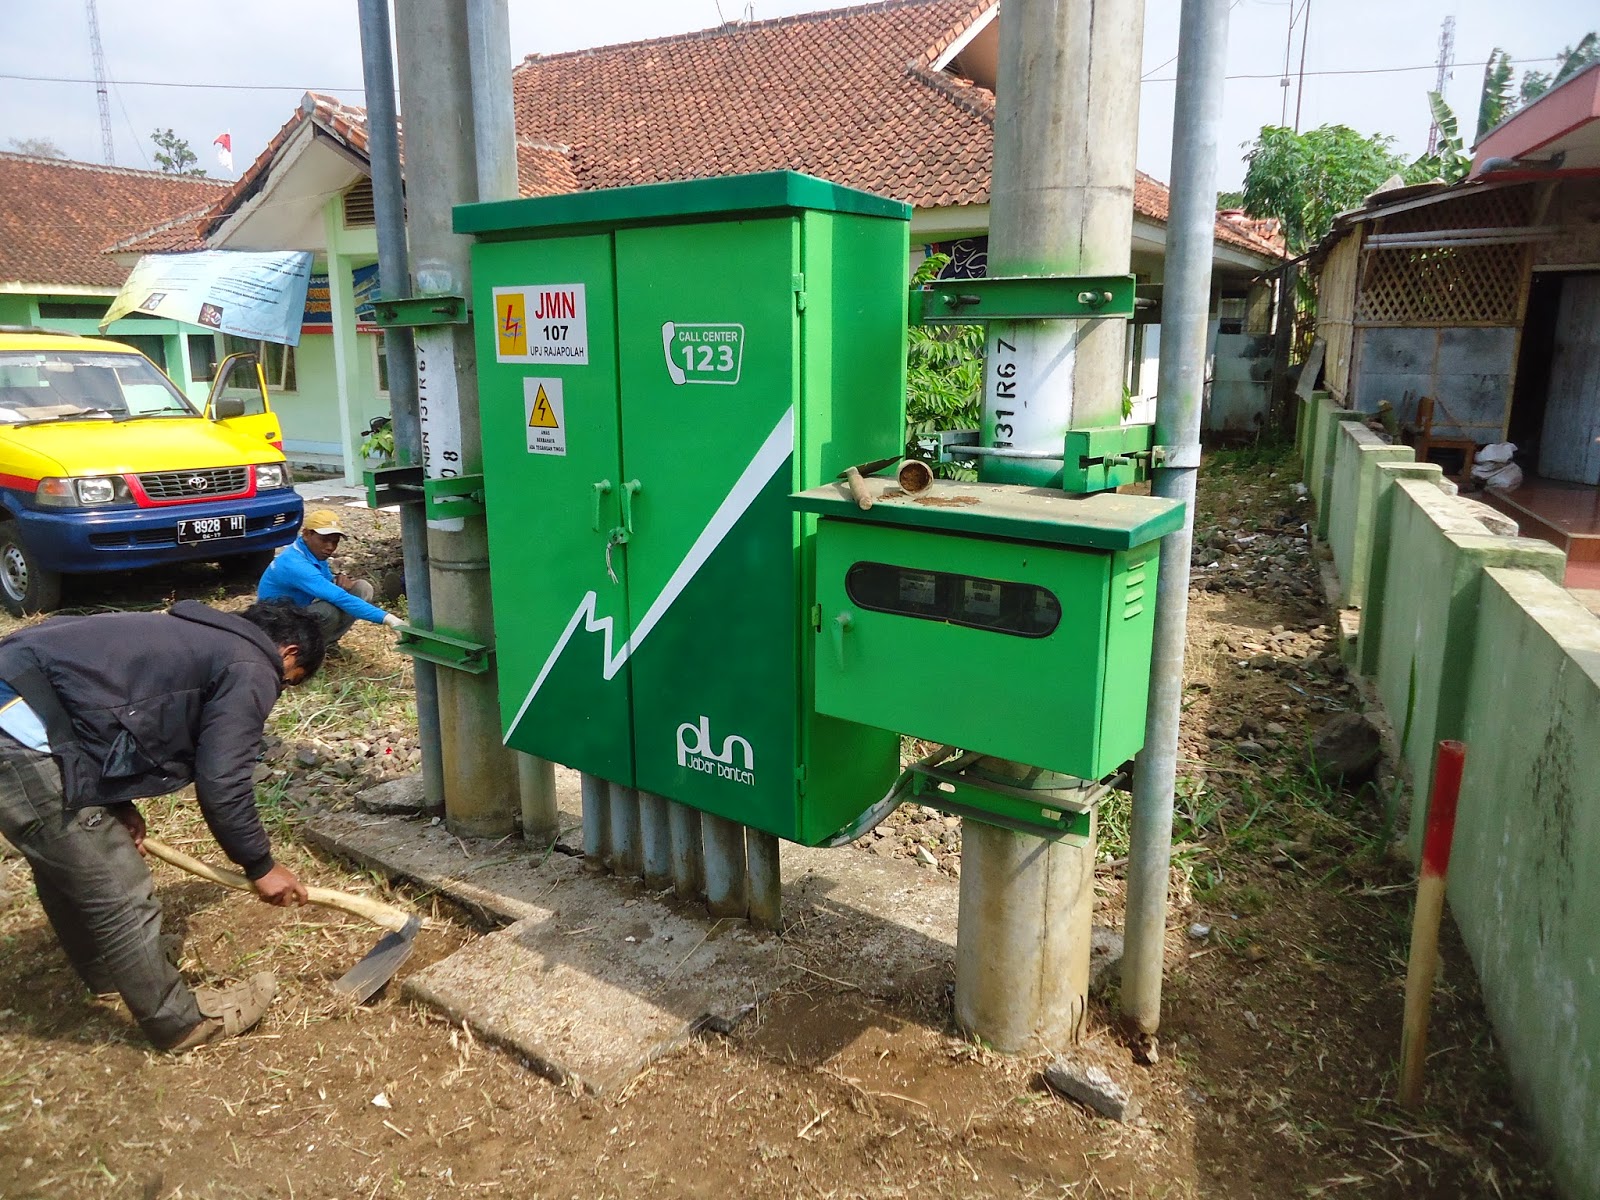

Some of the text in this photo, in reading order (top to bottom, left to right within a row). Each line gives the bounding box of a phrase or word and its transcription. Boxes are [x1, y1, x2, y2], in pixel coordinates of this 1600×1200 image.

[535, 291, 576, 319] JMN
[543, 325, 569, 341] 107
[679, 331, 738, 342] CALL CENTER
[530, 346, 584, 357] UPJ RAJAPOLAH
[682, 345, 734, 371] 123
[179, 516, 243, 536] Z 8928 HI
[676, 715, 753, 770] pln
